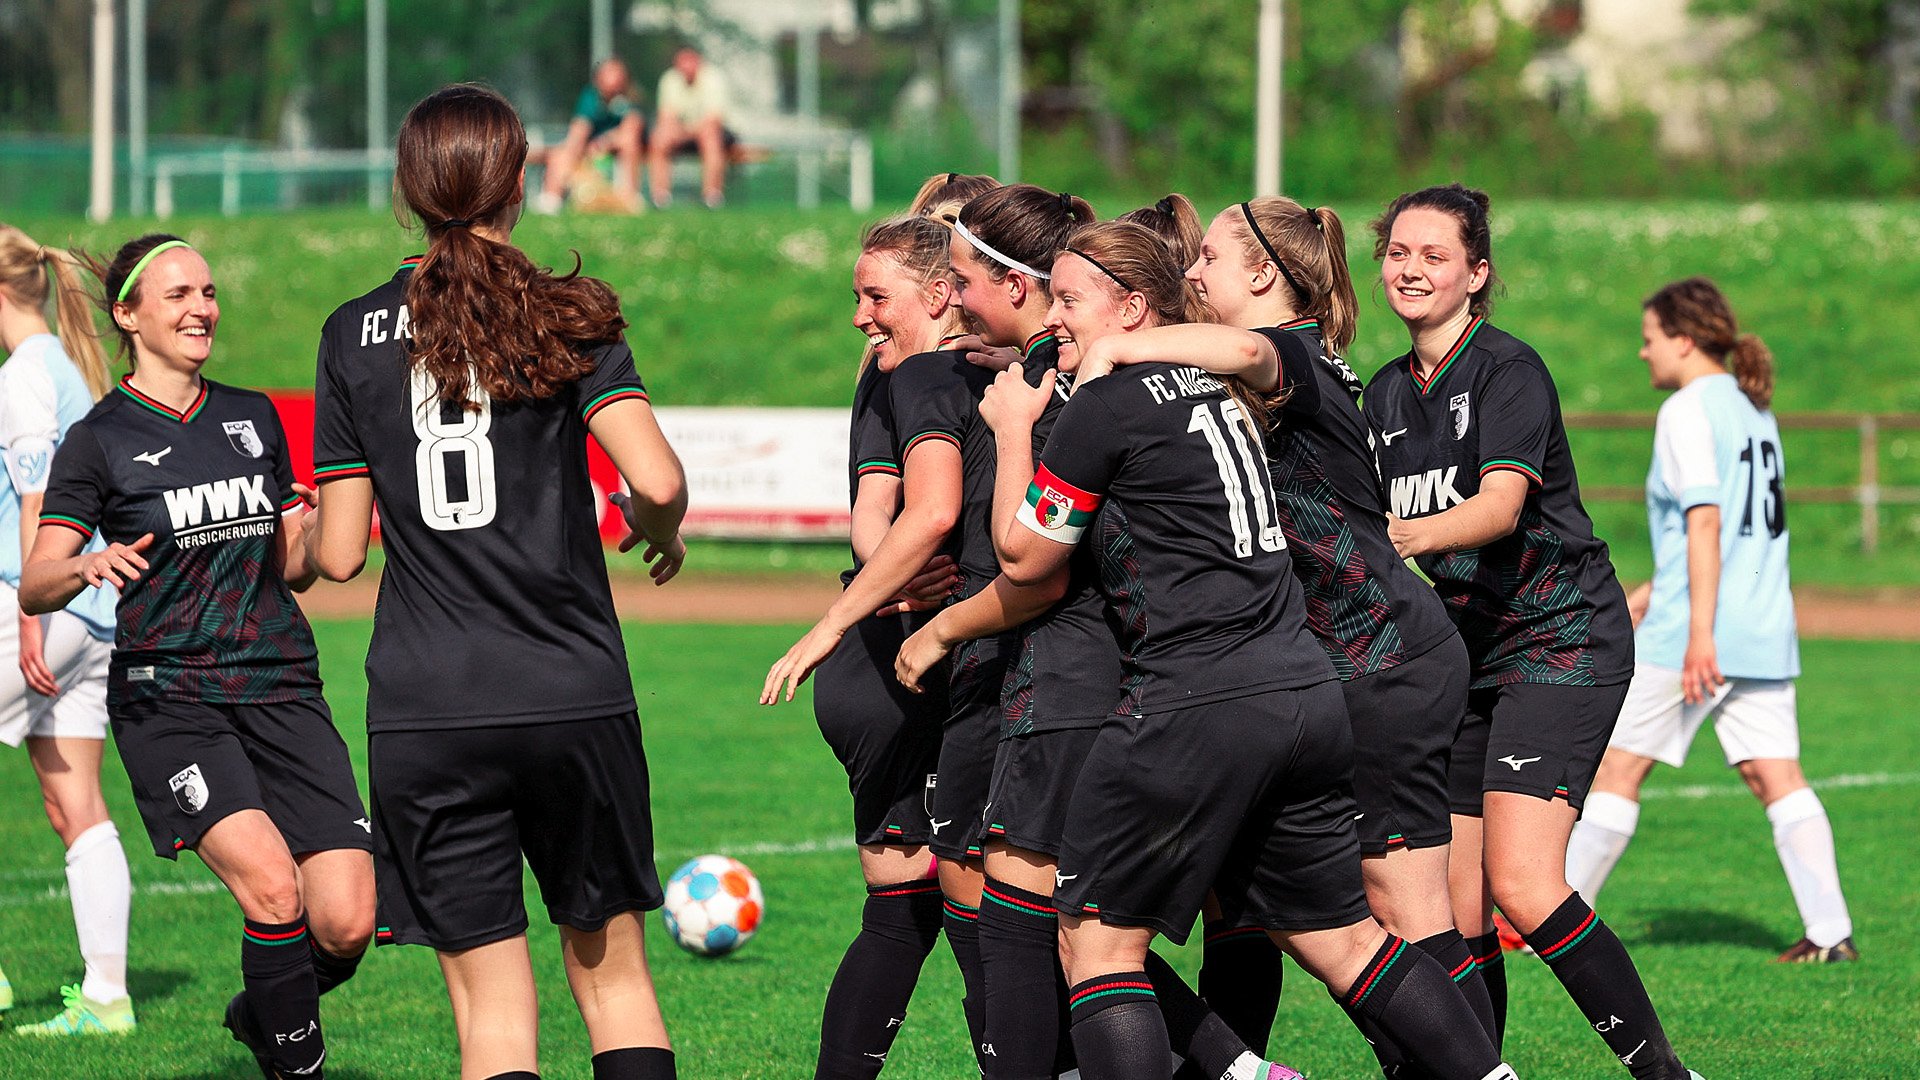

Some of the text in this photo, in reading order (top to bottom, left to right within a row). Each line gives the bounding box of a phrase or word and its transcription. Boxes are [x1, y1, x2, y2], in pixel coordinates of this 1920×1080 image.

[361, 308, 389, 347] FC
[1141, 373, 1177, 405] FC
[1451, 394, 1468, 408] FCA
[227, 422, 252, 432] FCA
[410, 350, 497, 531] 8
[1187, 398, 1288, 559] 10
[1739, 437, 1785, 539] 13
[163, 474, 275, 531] WWK
[1046, 488, 1069, 508] FCA
[175, 521, 275, 550] VERSICHERUNGEN
[172, 769, 197, 788] FCA
[275, 1019, 318, 1046] FCA
[1591, 1014, 1624, 1032] CA
